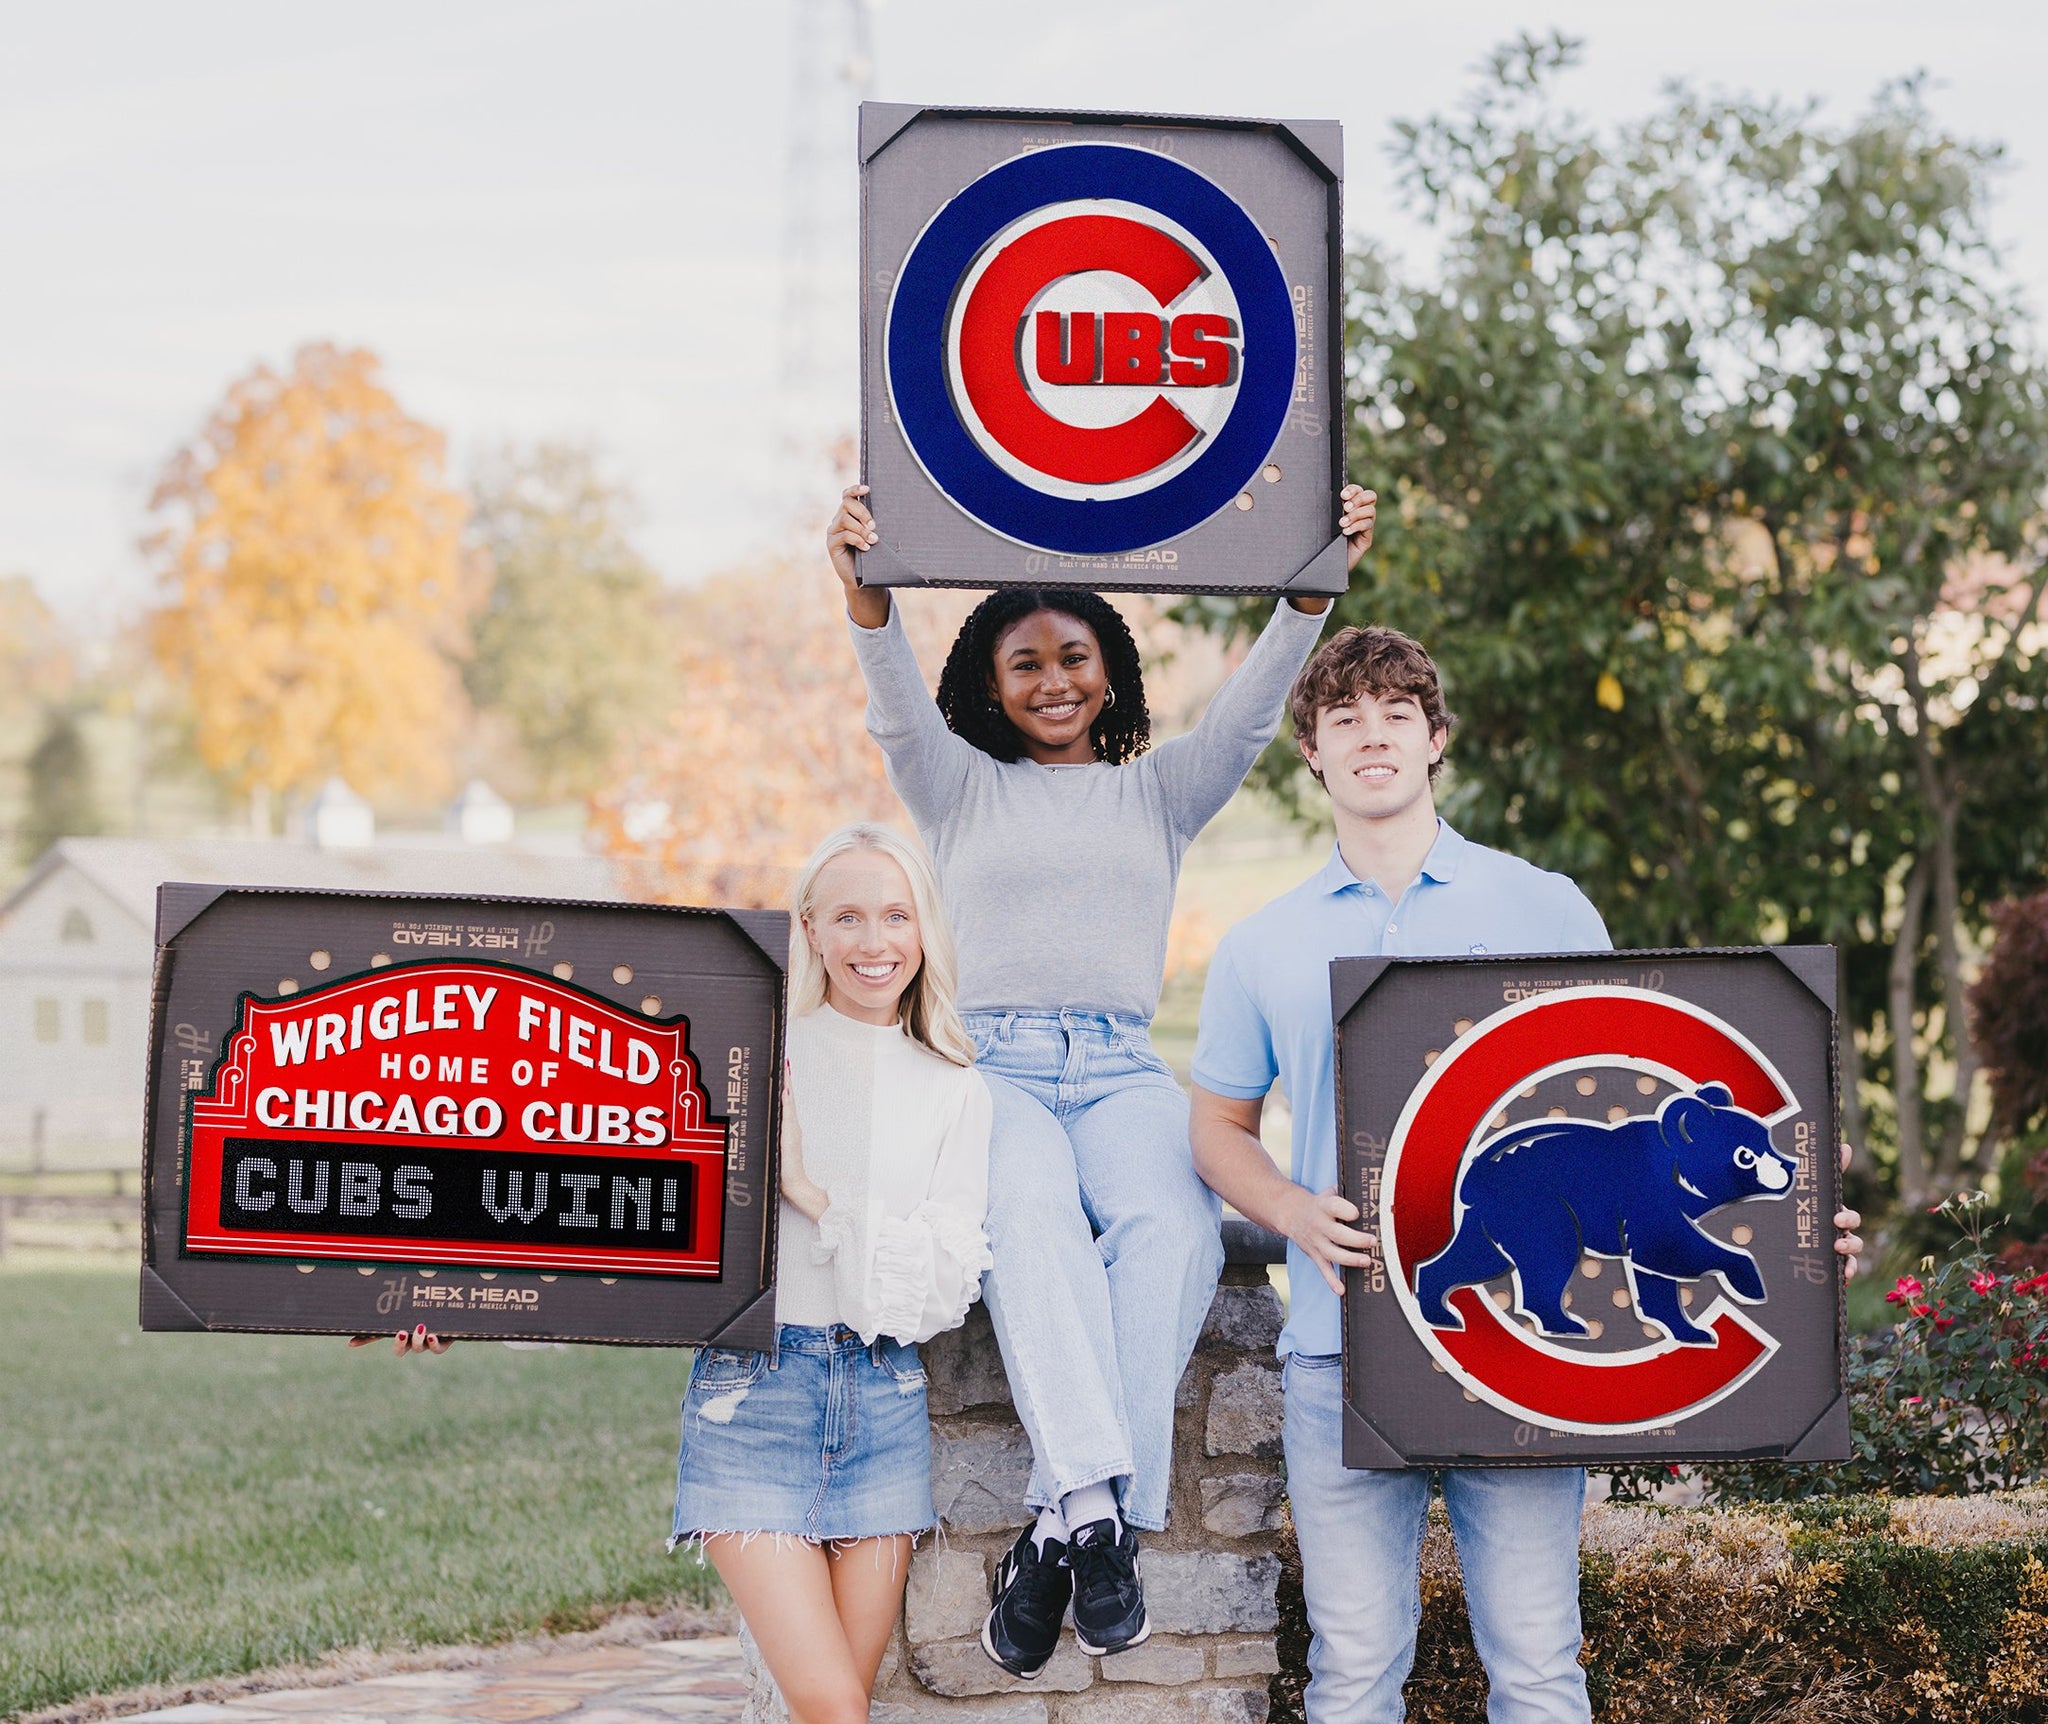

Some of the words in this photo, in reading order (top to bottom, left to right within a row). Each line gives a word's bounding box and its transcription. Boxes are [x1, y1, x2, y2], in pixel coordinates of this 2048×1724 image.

[424, 923, 452, 931] AMERICA
[392, 930, 461, 947] HEAD
[467, 934, 519, 949] HEX
[269, 984, 499, 1067] WRIGLEY
[518, 995, 661, 1086] FIELD
[743, 1047, 751, 1059] YOU
[188, 1059, 204, 1090] HE
[380, 1052, 489, 1084] HOME
[511, 1059, 560, 1087] OF
[727, 1046, 742, 1114] HEAD
[741, 1077, 749, 1106] AMERICA
[255, 1086, 504, 1138] CHICAGO
[521, 1100, 668, 1147] CUBS
[741, 1108, 748, 1117] IN
[740, 1120, 748, 1137] HAND
[1809, 1121, 1817, 1133] YOU
[727, 1121, 740, 1171] HEX
[739, 1140, 747, 1149] BY
[1809, 1137, 1817, 1150] FOR
[1794, 1122, 1810, 1190] HEAD
[1810, 1153, 1818, 1181] AMERICA
[235, 1157, 434, 1219] CUBS
[482, 1169, 678, 1232] WIN!
[1369, 1167, 1382, 1218] HEX
[1811, 1184, 1818, 1192] IN
[1796, 1197, 1811, 1248] HEX
[1811, 1215, 1819, 1224] BY
[412, 1285, 464, 1300] HEX
[470, 1287, 539, 1303] HEAD
[510, 1303, 522, 1311] FOR
[526, 1304, 539, 1312] YOU
